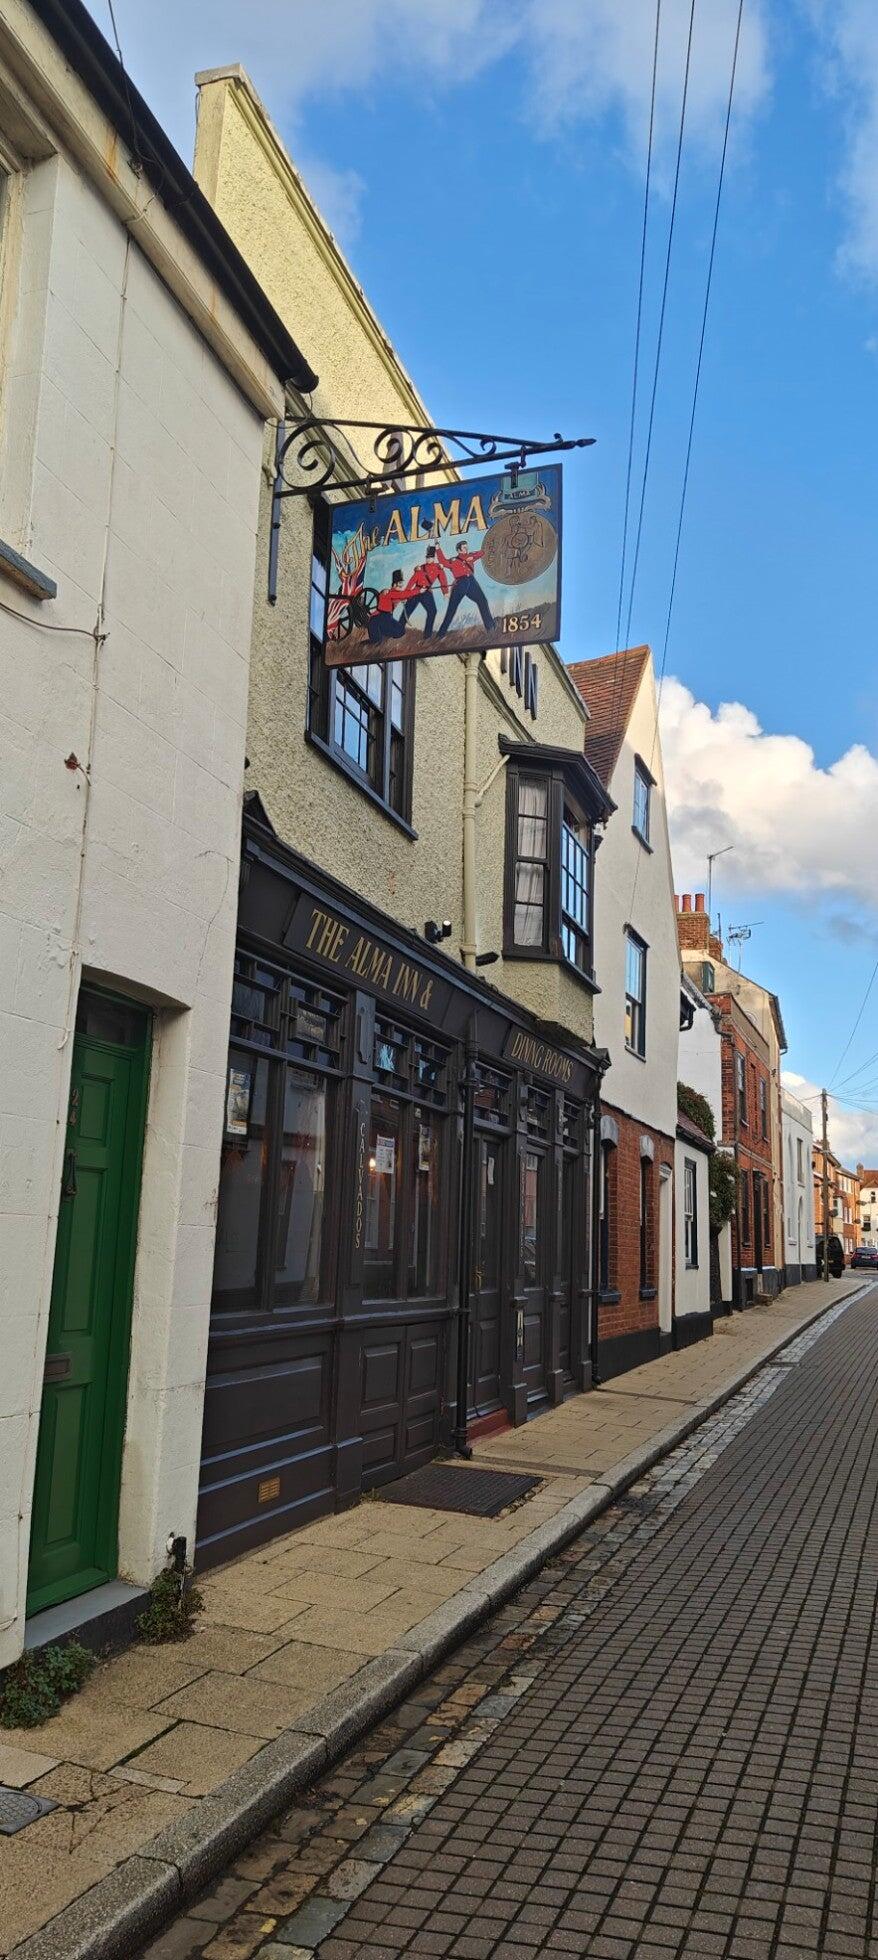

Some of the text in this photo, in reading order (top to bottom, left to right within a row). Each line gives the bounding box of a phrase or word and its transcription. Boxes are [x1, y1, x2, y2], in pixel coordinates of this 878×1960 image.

[341, 495, 488, 577] The ALMA
[502, 613, 542, 634] 1854
[305, 908, 434, 1010] THE ALMA INN &
[511, 1032, 575, 1083] DINING ROOMS
[354, 1122, 366, 1249] CALVADOS
